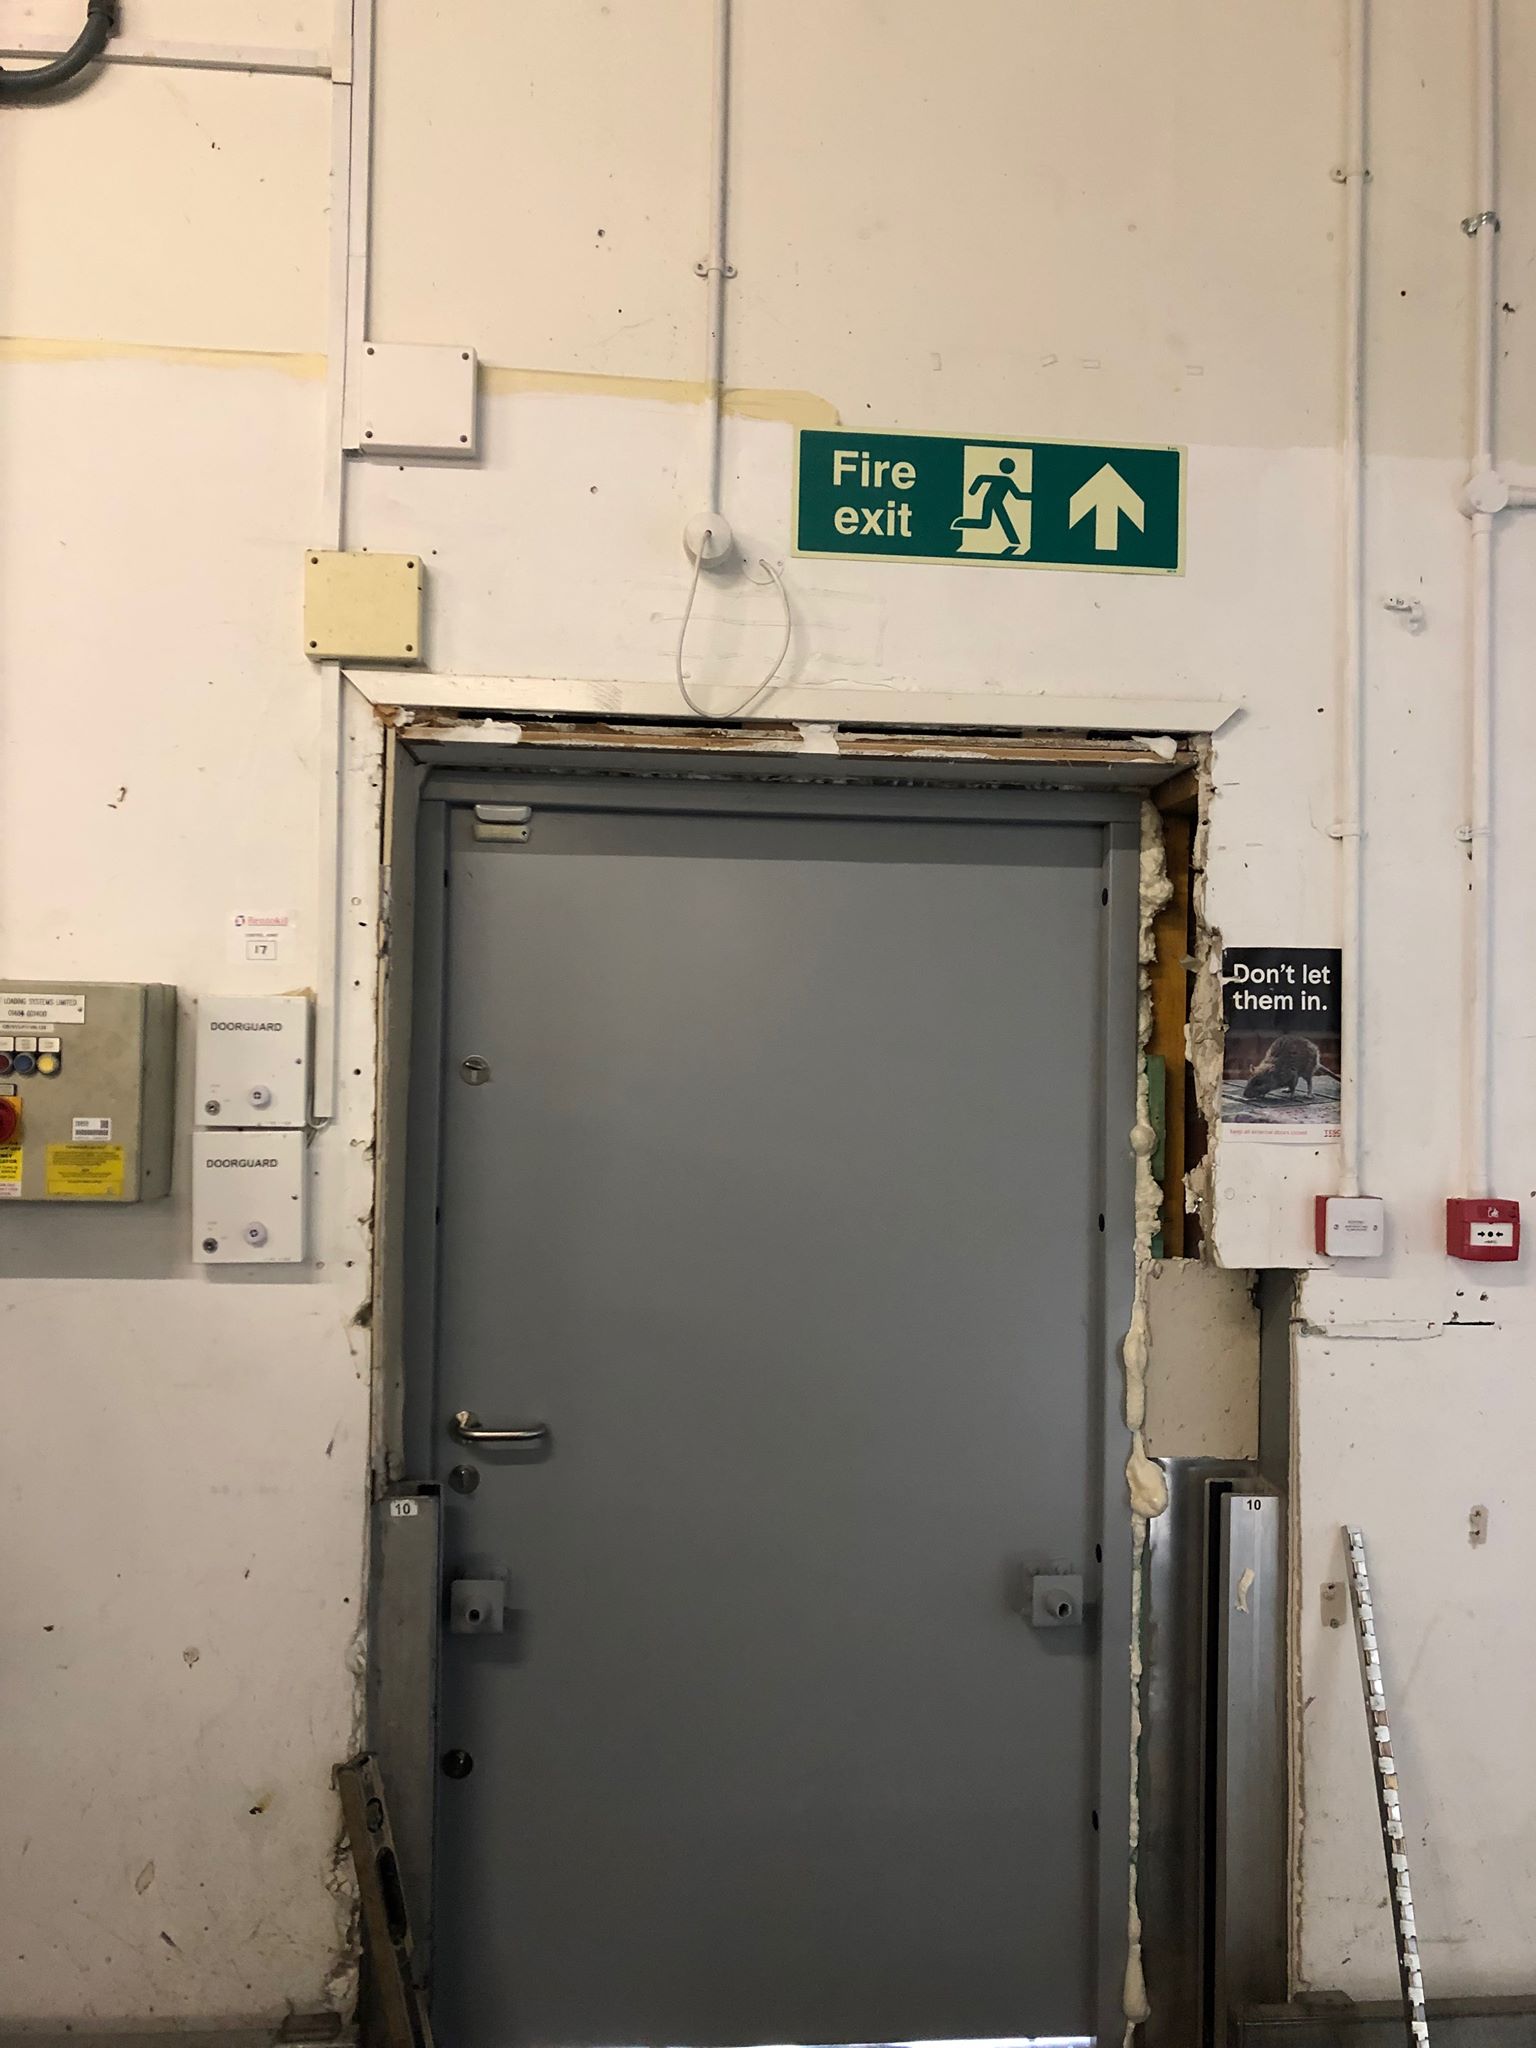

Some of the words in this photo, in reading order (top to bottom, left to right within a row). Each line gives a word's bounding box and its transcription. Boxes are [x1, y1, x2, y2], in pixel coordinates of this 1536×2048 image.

[832, 449, 917, 490] Fire
[833, 500, 913, 538] exit
[254, 945, 268, 955] 17
[1233, 963, 1296, 984] Don’t
[1302, 963, 1331, 985] let
[1232, 989, 1294, 1011] them
[1301, 990, 1328, 1011] in.
[210, 1022, 283, 1032] DOORGUARD
[1323, 1129, 1341, 1138] TESC
[206, 1158, 279, 1168] DOORGUARD
[395, 1502, 411, 1515] 10
[1246, 1499, 1262, 1511] 10
